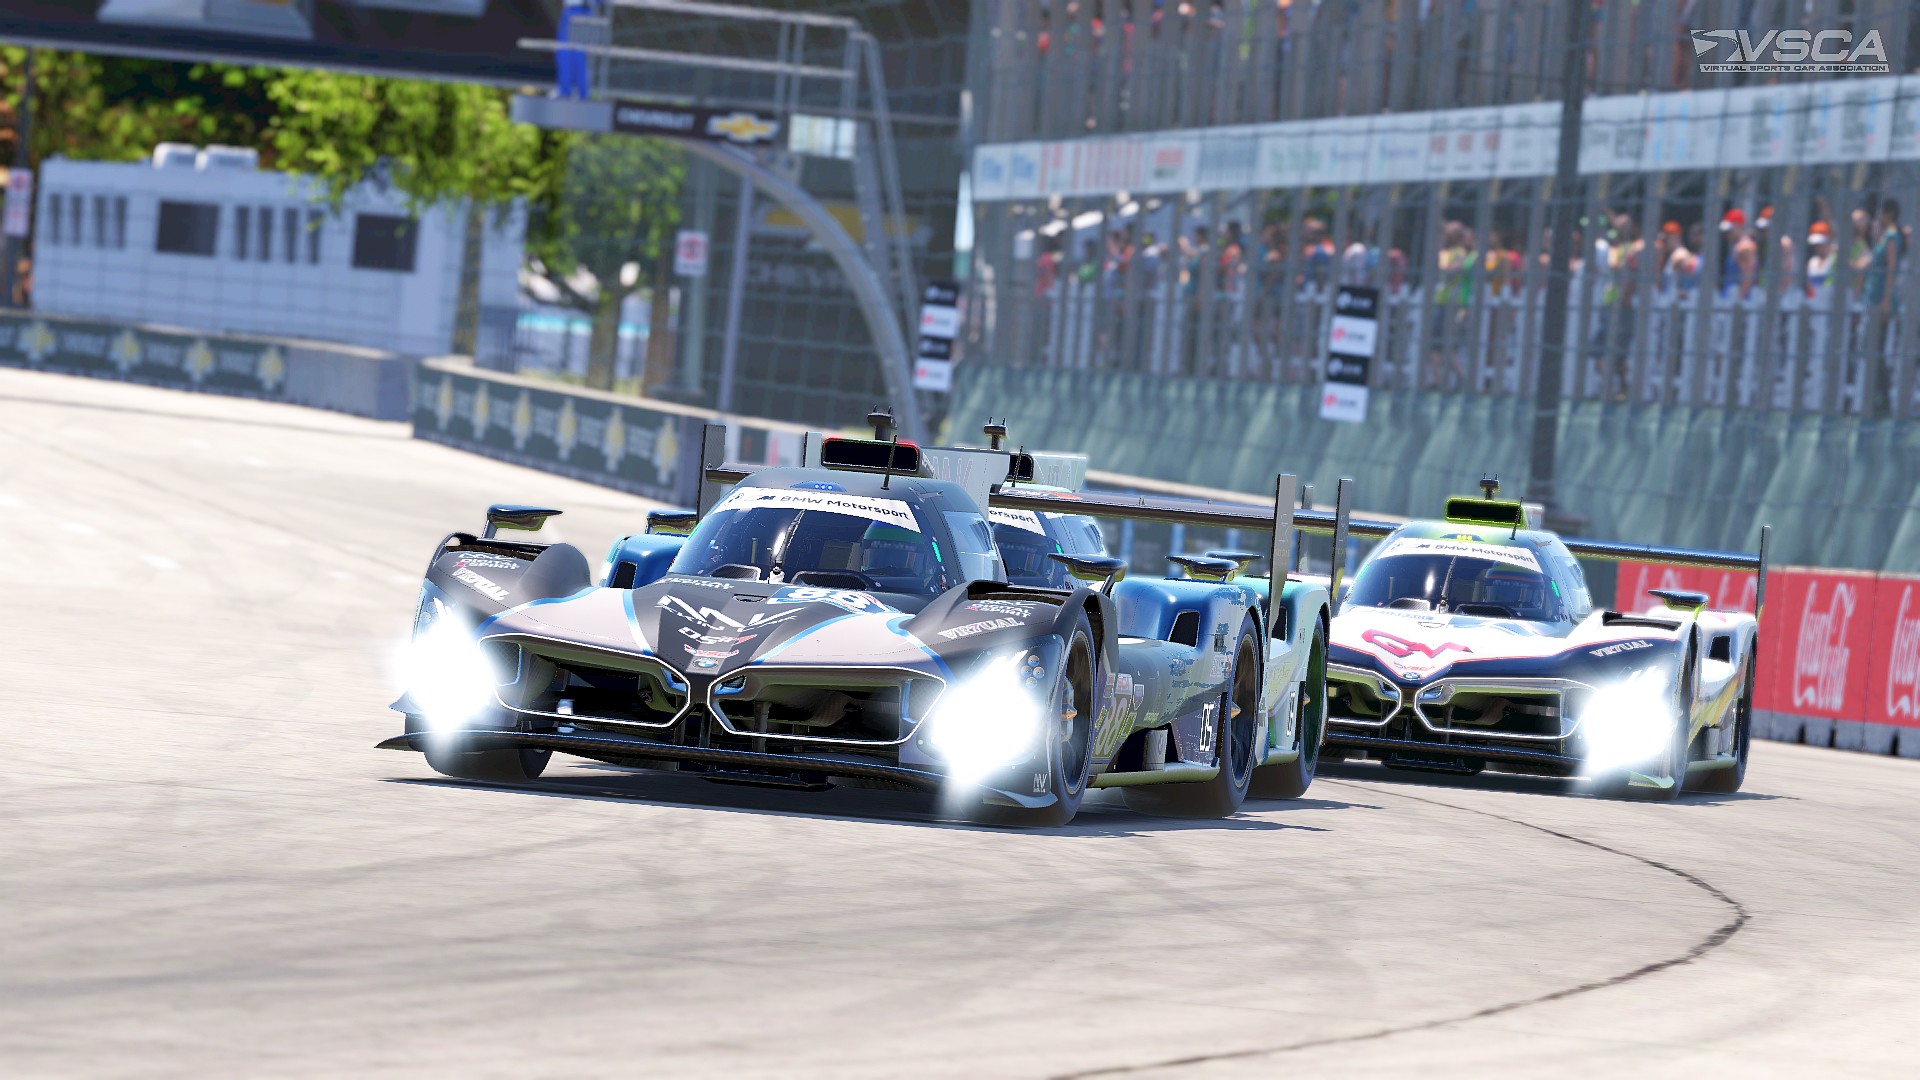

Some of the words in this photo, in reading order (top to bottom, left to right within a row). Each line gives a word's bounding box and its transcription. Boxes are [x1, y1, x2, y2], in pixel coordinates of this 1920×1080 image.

[780, 495, 823, 504] BMW
[827, 499, 910, 520] Motorsport
[1472, 546, 1534, 564] Motorsport
